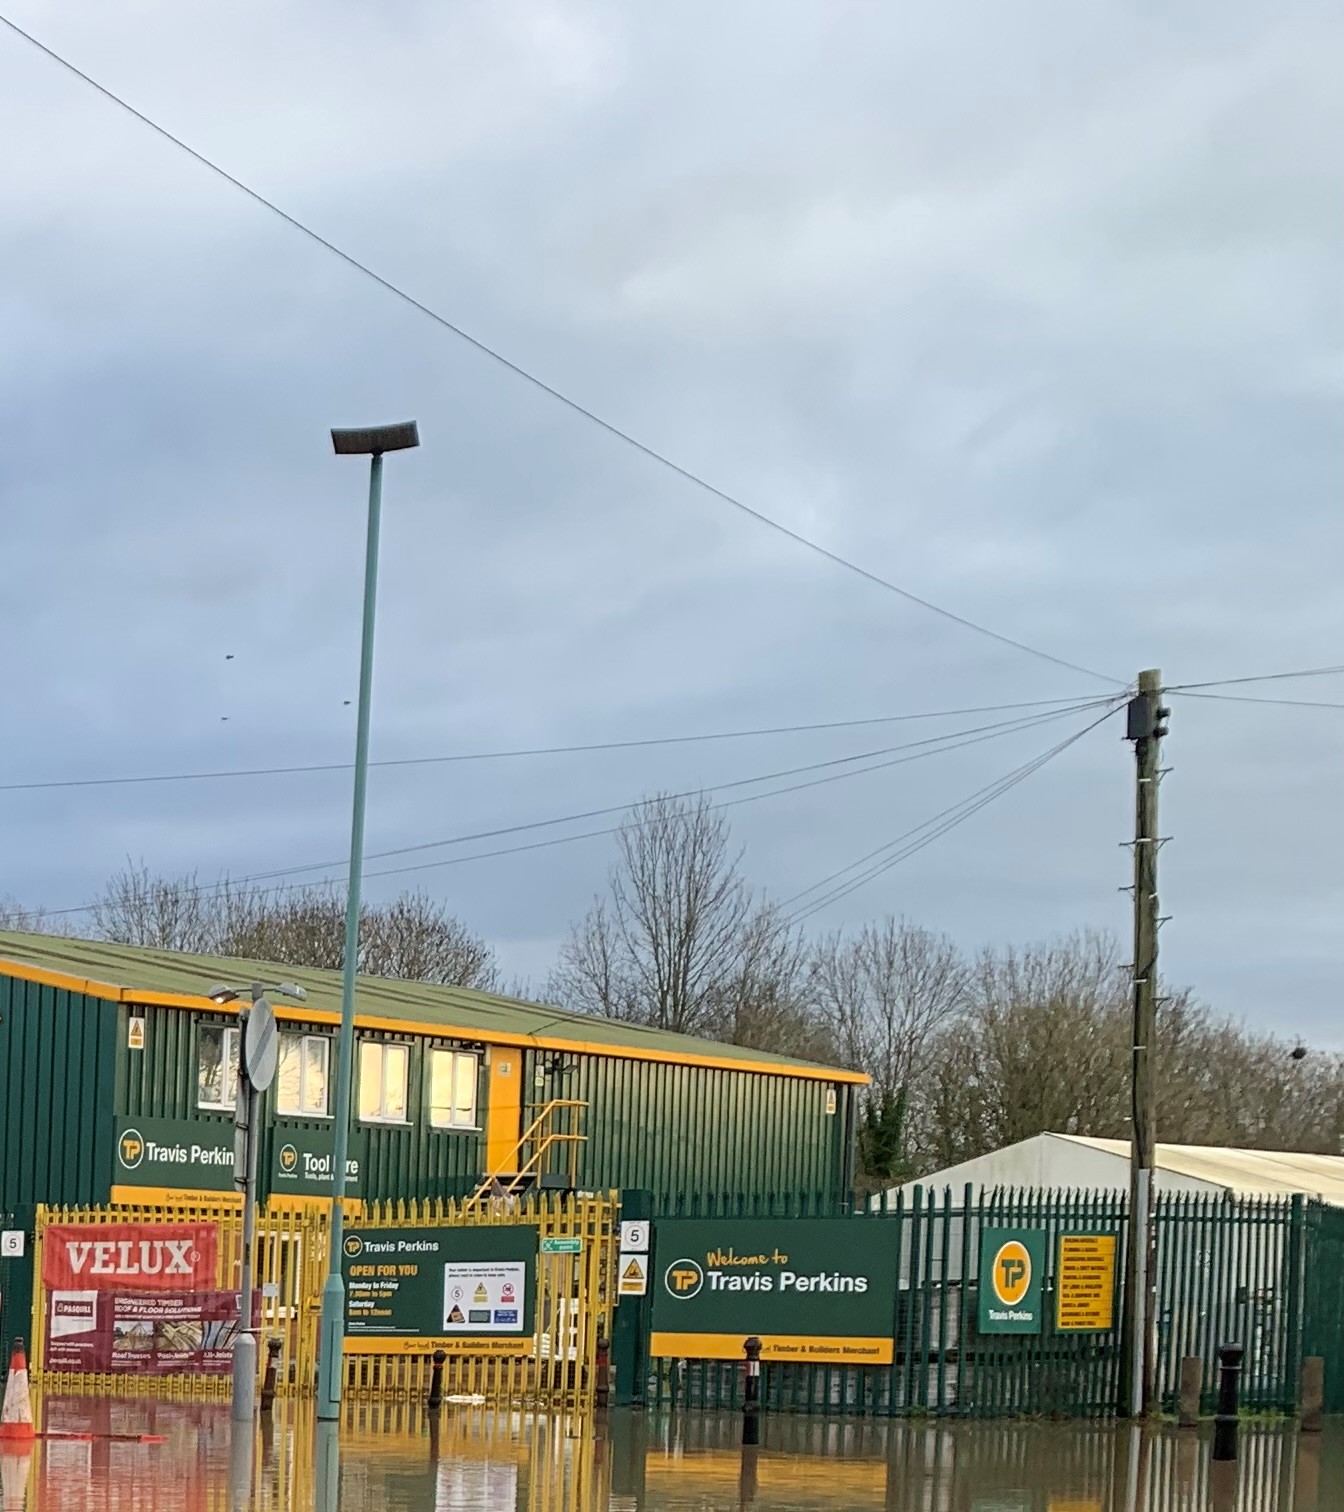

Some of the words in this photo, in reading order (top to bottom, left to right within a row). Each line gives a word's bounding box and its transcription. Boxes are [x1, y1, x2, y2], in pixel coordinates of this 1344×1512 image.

[146, 1141, 188, 1163] Travis
[190, 1145, 234, 1166] Perkin
[303, 1152, 330, 1172] Tool
[631, 1229, 639, 1242] 5
[9, 1238, 17, 1249] 5
[364, 1240, 395, 1252] Travis
[397, 1240, 439, 1252] Perkins
[66, 1239, 194, 1275] VELUX
[707, 1247, 769, 1268] Welcome
[771, 1248, 788, 1265] to
[349, 1265, 375, 1276] OPEN
[377, 1265, 396, 1276] FOR
[398, 1264, 418, 1276] YOU
[1001, 1259, 1026, 1288] TP
[348, 1282, 372, 1290] Monday
[380, 1281, 399, 1290] Friday
[671, 1269, 698, 1291] TP
[706, 1270, 773, 1292] Travis
[779, 1271, 868, 1293] Perkins
[454, 1290, 460, 1298] 5
[63, 1305, 91, 1314] PASQUILL
[989, 1309, 1008, 1320] Travis
[1009, 1309, 1033, 1321] Perkins
[431, 1341, 454, 1349] Timber
[462, 1341, 490, 1349] Builders
[491, 1341, 524, 1349] Merchant
[773, 1344, 799, 1353] Timber
[801, 1345, 806, 1353] &
[808, 1345, 840, 1354] Builders
[842, 1346, 880, 1355] Merchant
